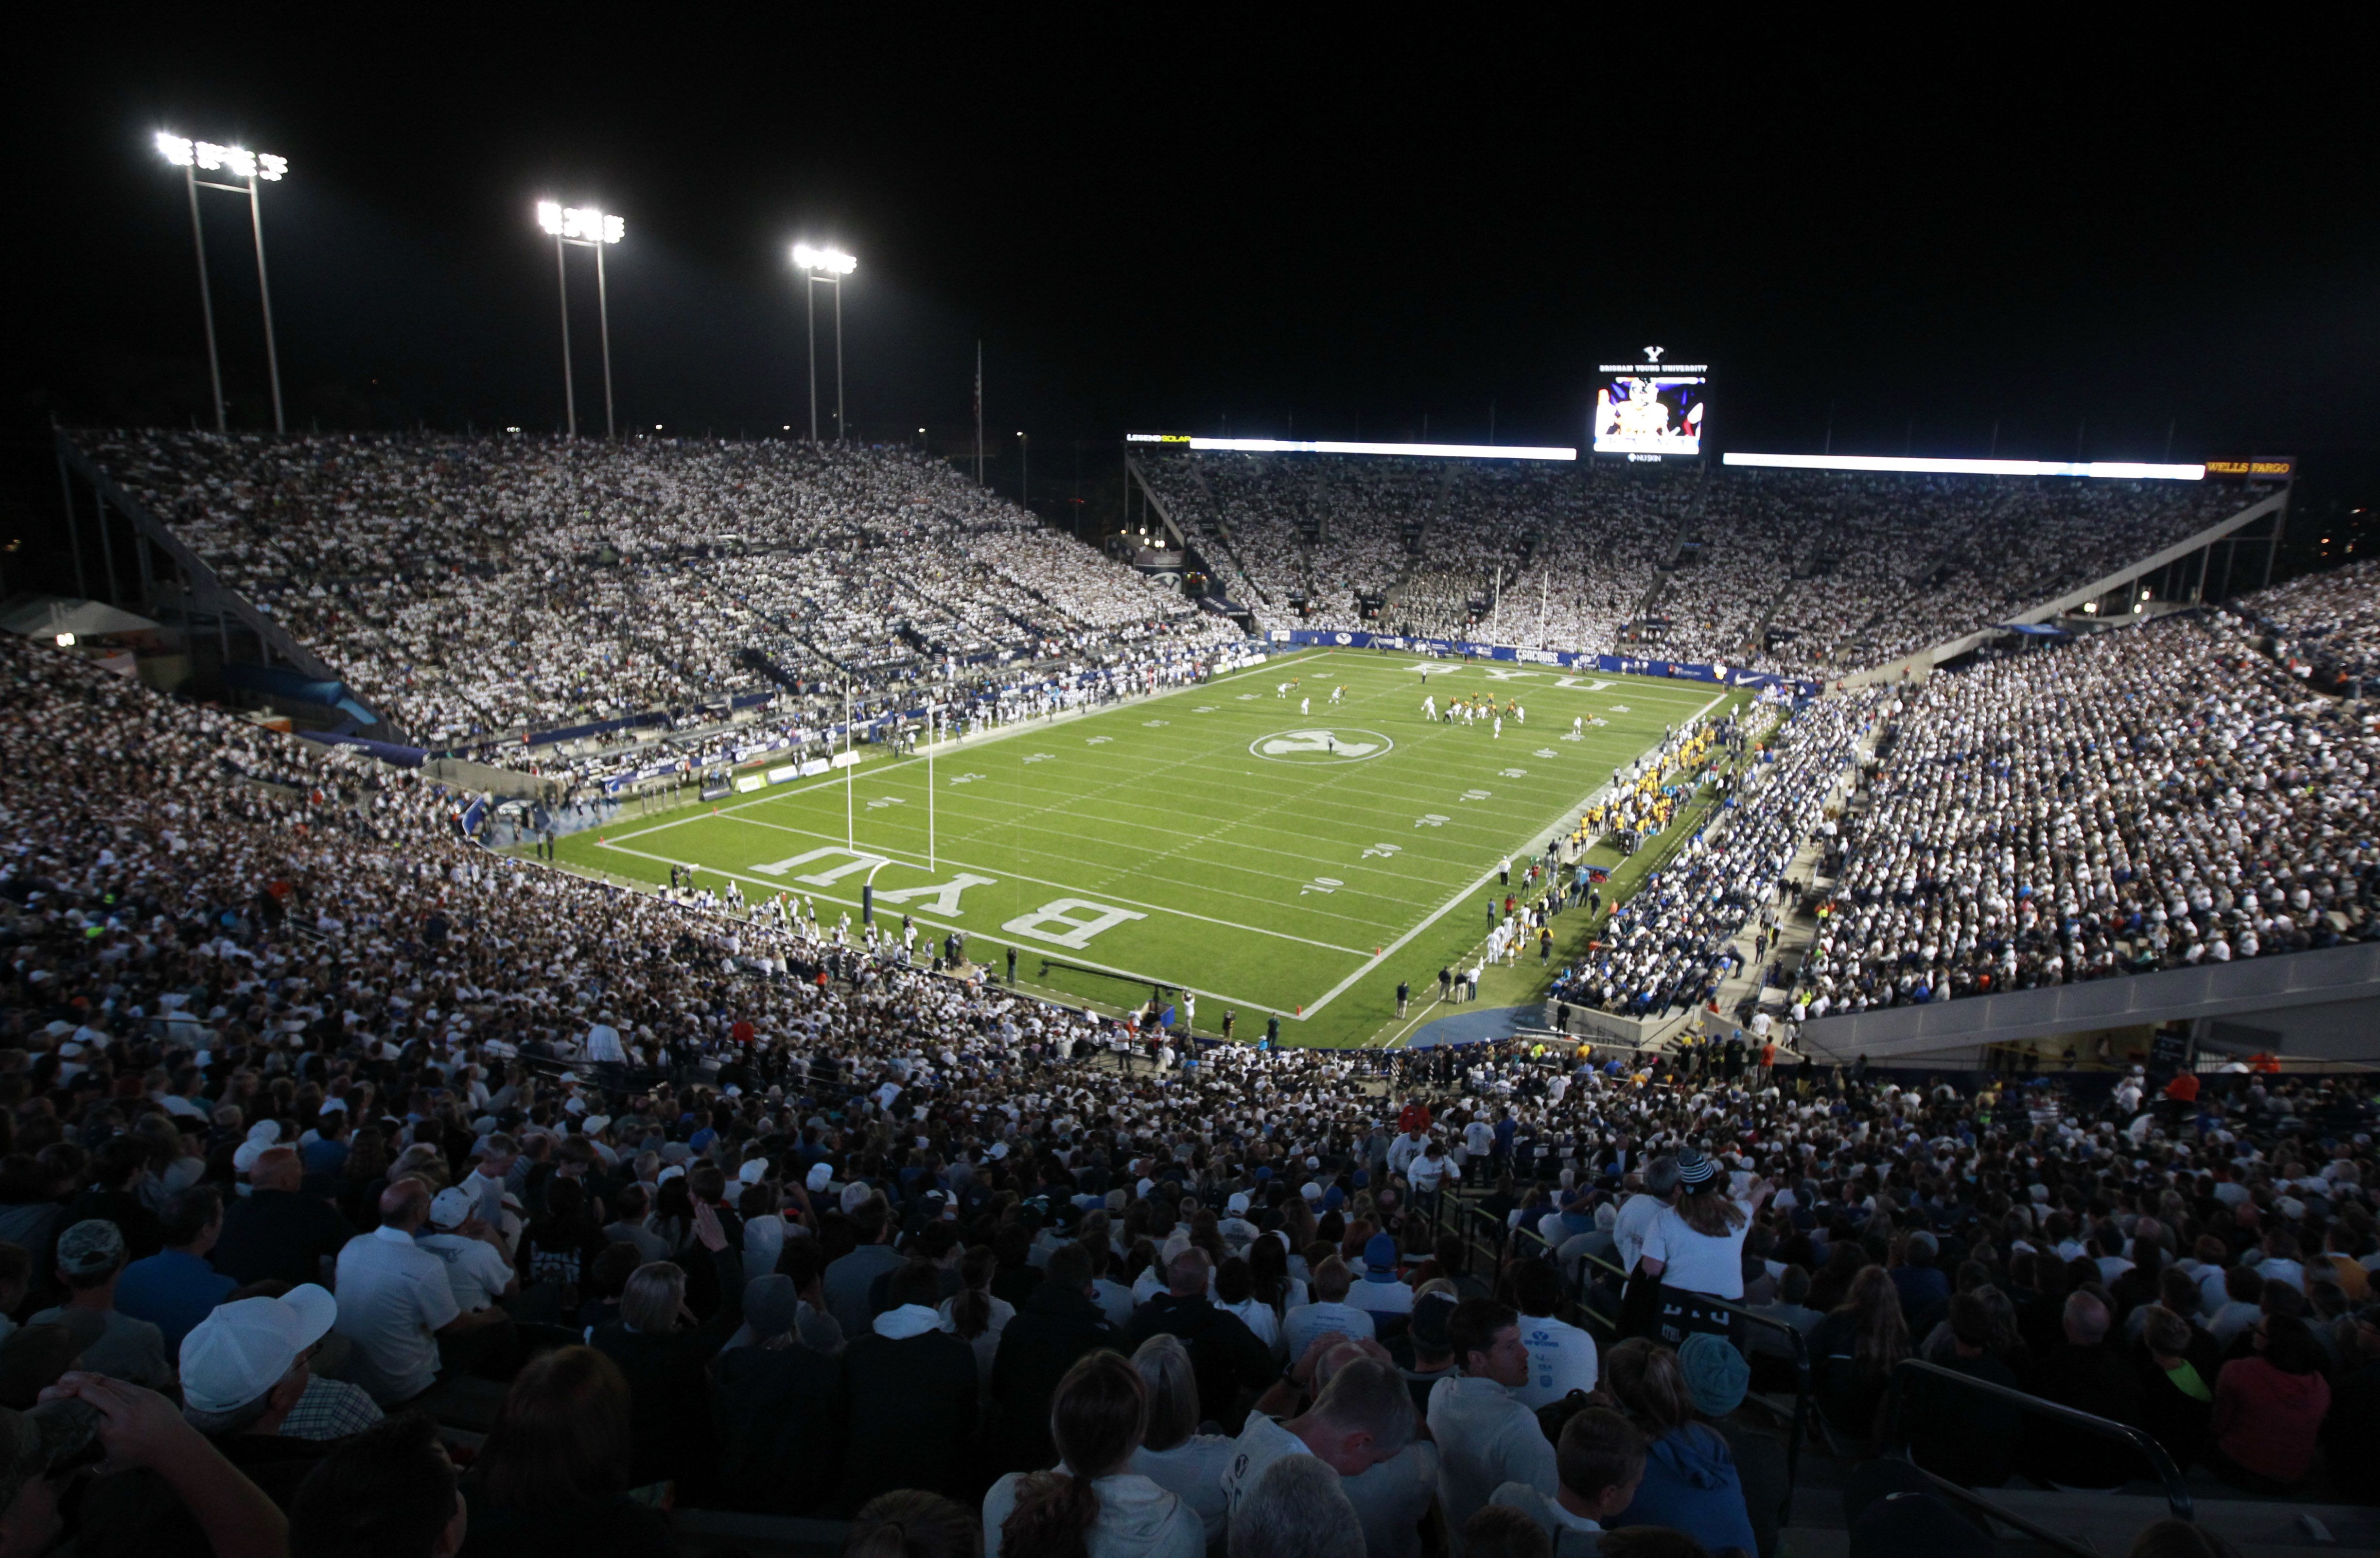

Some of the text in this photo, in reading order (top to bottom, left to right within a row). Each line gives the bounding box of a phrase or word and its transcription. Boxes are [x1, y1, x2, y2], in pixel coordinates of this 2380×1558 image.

[2206, 462, 2291, 474] WELLS FARGO
[1364, 843, 1402, 858] 20
[1302, 876, 1345, 894] 10
